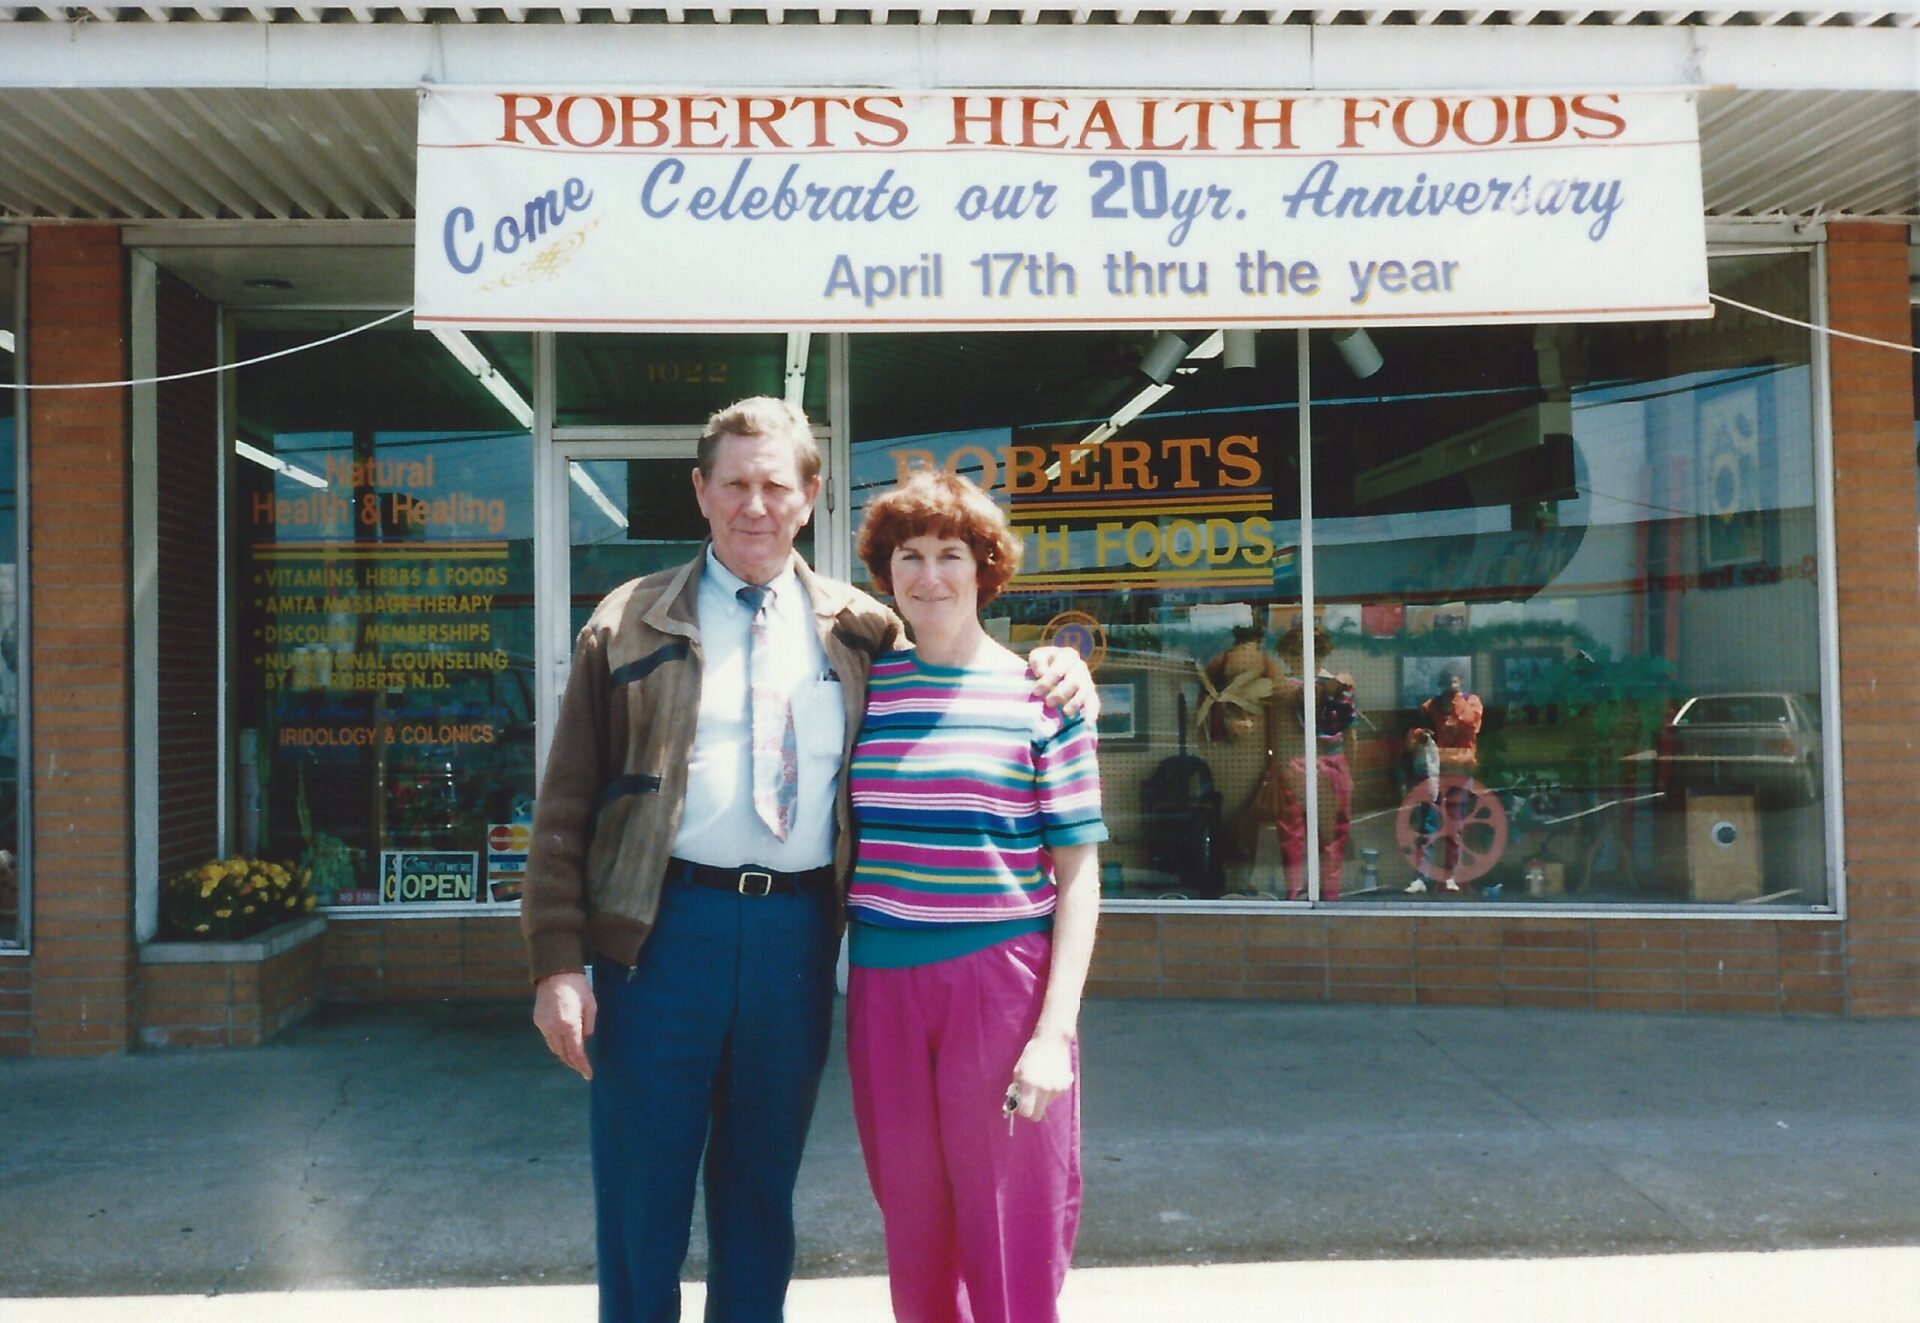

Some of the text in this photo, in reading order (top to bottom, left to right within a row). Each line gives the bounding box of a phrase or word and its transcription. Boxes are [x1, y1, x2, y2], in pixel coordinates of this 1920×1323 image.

[495, 94, 1627, 151] ROBERTS HEALTH FOODS
[443, 176, 594, 275] Come
[640, 157, 920, 222] Celebrate
[954, 178, 1058, 222] our
[1282, 158, 1625, 241] Anniversary
[823, 249, 1462, 307] April 17th thru the year
[647, 362, 728, 383] 1022
[325, 454, 434, 488] Natural
[888, 435, 1263, 494] ROBERTS
[252, 490, 506, 534] Health & Healing
[1096, 516, 1275, 568] FOODS
[365, 567, 422, 587] HERBS
[426, 568, 440, 586] &
[445, 566, 508, 587] FOODS
[265, 594, 494, 613] AMTA MASSAGE THERAPY
[264, 624, 491, 643] DISCOUNT MEMBERSHIPS
[391, 650, 509, 670] COUNSELING
[264, 672, 287, 689] BY
[329, 671, 406, 689] ROBERTS
[279, 724, 494, 747] IRIDOLOGY & COLONICS
[402, 873, 472, 899] OPEN
